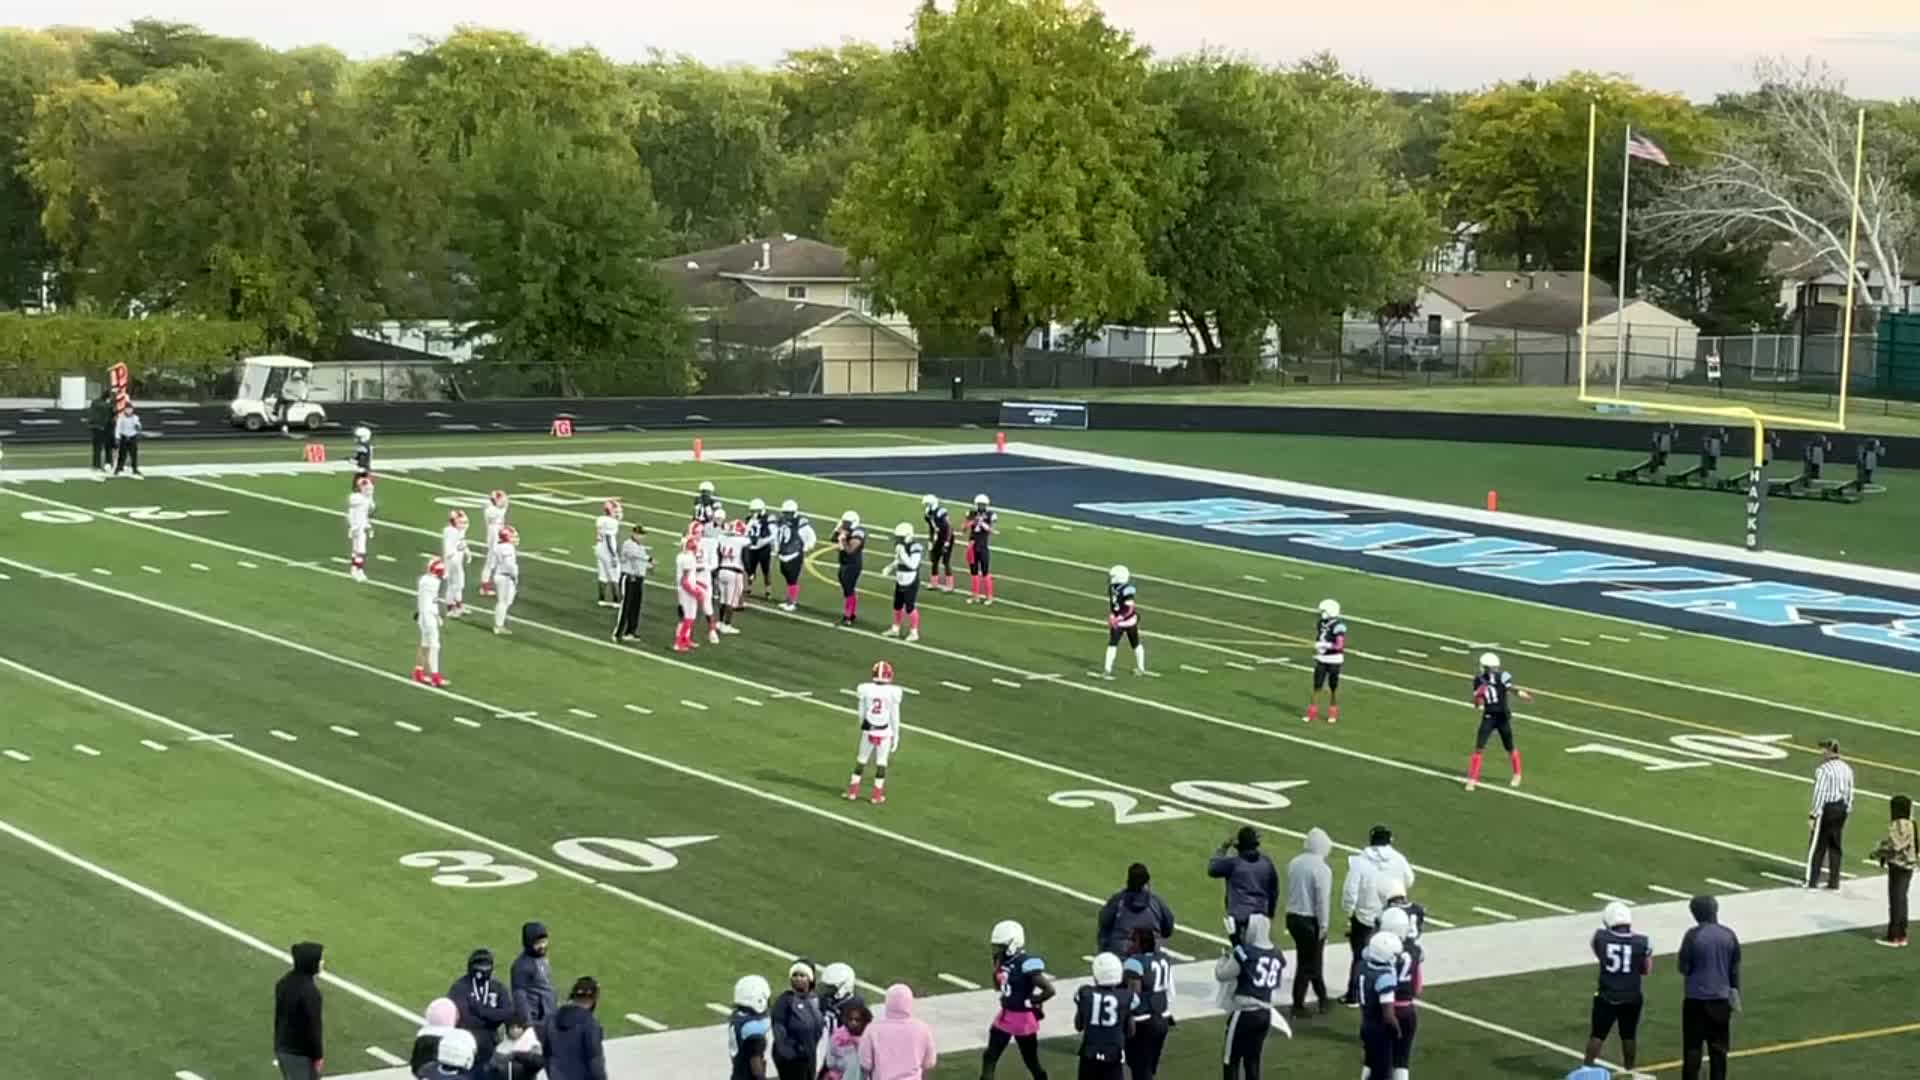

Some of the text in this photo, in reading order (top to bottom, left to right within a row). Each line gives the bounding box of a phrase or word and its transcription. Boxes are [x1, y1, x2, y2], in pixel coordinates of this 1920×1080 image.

[871, 698, 883, 715] 2
[1565, 735, 1788, 771] 10
[1048, 780, 1291, 824] 20
[399, 837, 679, 887] 30
[1252, 956, 1281, 987] 58
[1605, 943, 1632, 973] 51
[1090, 992, 1119, 1027] 13
